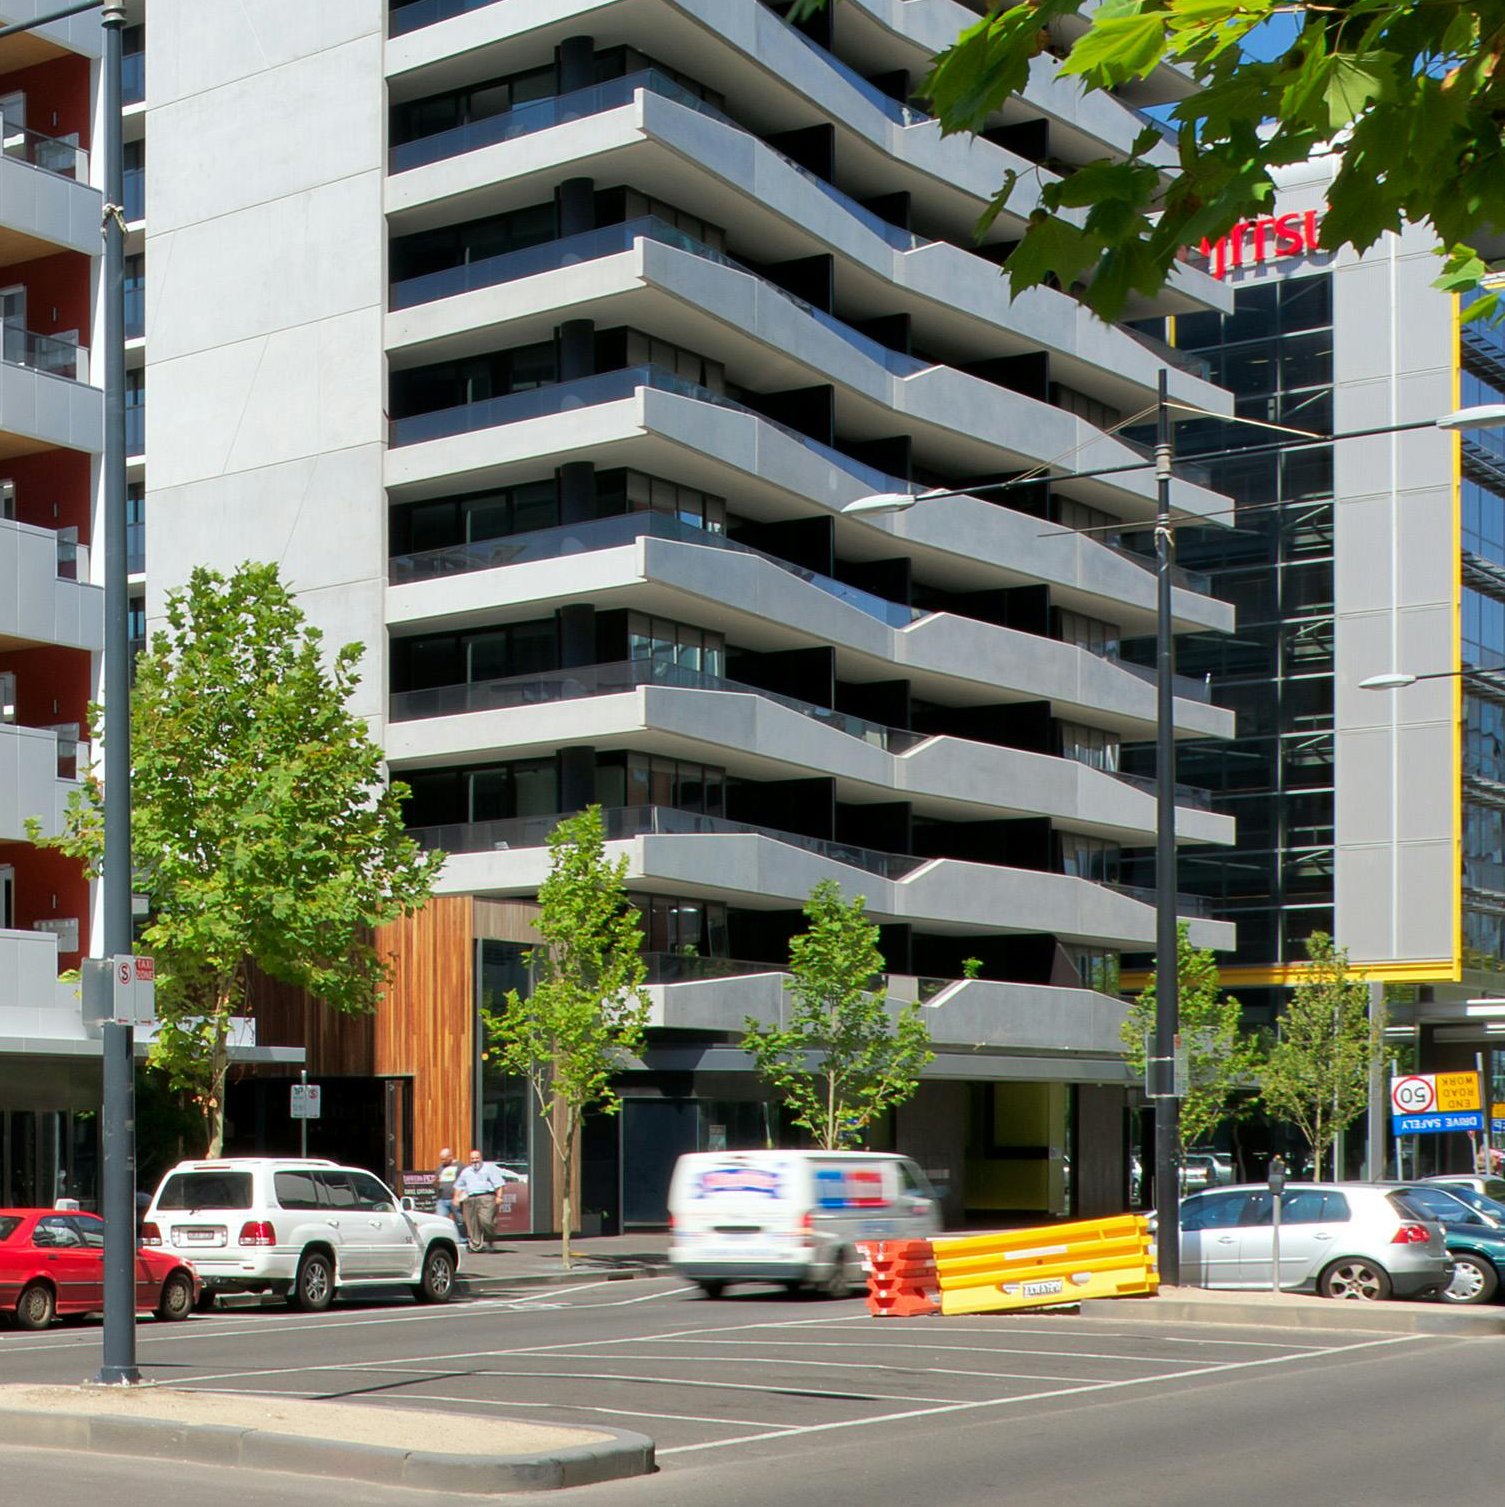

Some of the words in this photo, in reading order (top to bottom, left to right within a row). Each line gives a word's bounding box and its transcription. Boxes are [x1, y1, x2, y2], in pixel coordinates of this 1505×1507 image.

[1441, 1076, 1474, 1086] WORK
[1401, 1087, 1426, 1104] 50
[1442, 1087, 1474, 1098] ROAD
[1448, 1099, 1471, 1108] END
[1401, 1118, 1441, 1130] SAFELY
[1444, 1116, 1477, 1127] DRIVE
